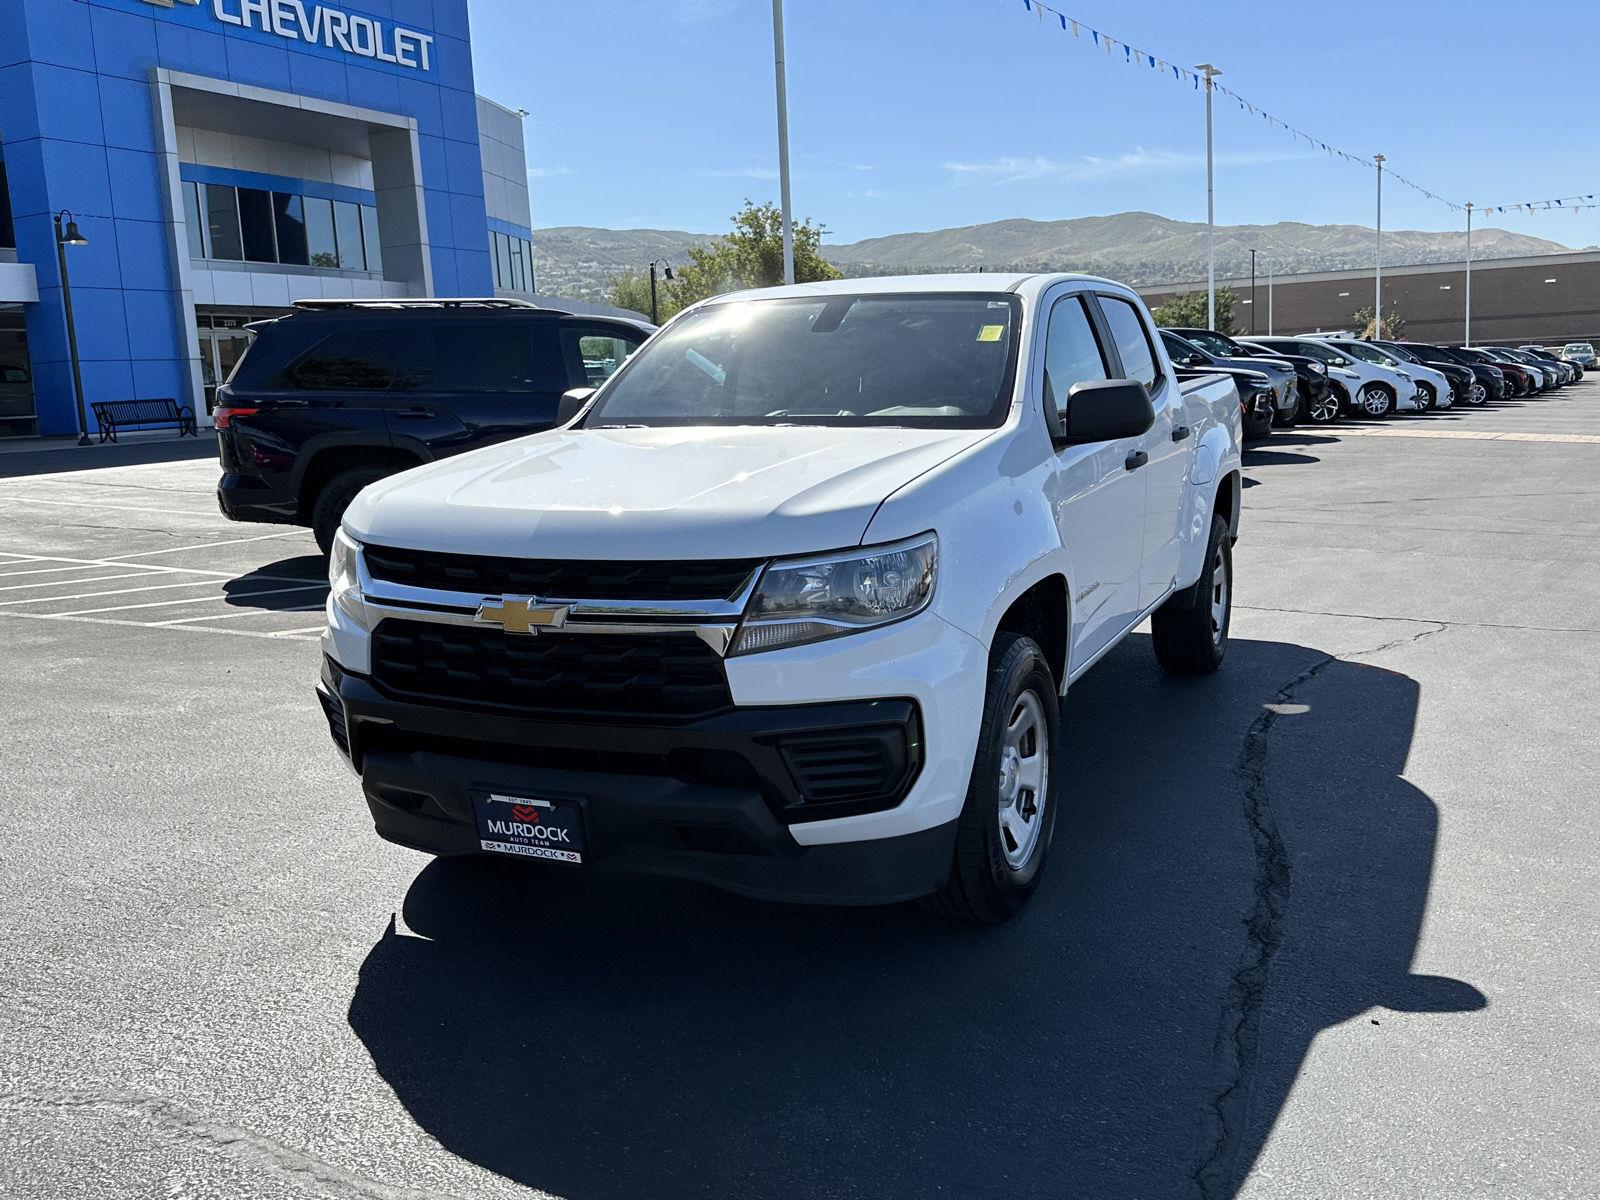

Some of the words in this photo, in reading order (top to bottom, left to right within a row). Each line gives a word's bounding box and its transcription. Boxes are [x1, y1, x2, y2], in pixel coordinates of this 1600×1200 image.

[212, 0, 433, 71] CHEVROLET
[487, 819, 570, 843] MURDOCK
[503, 843, 558, 859] MURDOCK
[510, 836, 529, 844] AUTO
[530, 838, 550, 847] TEAM
